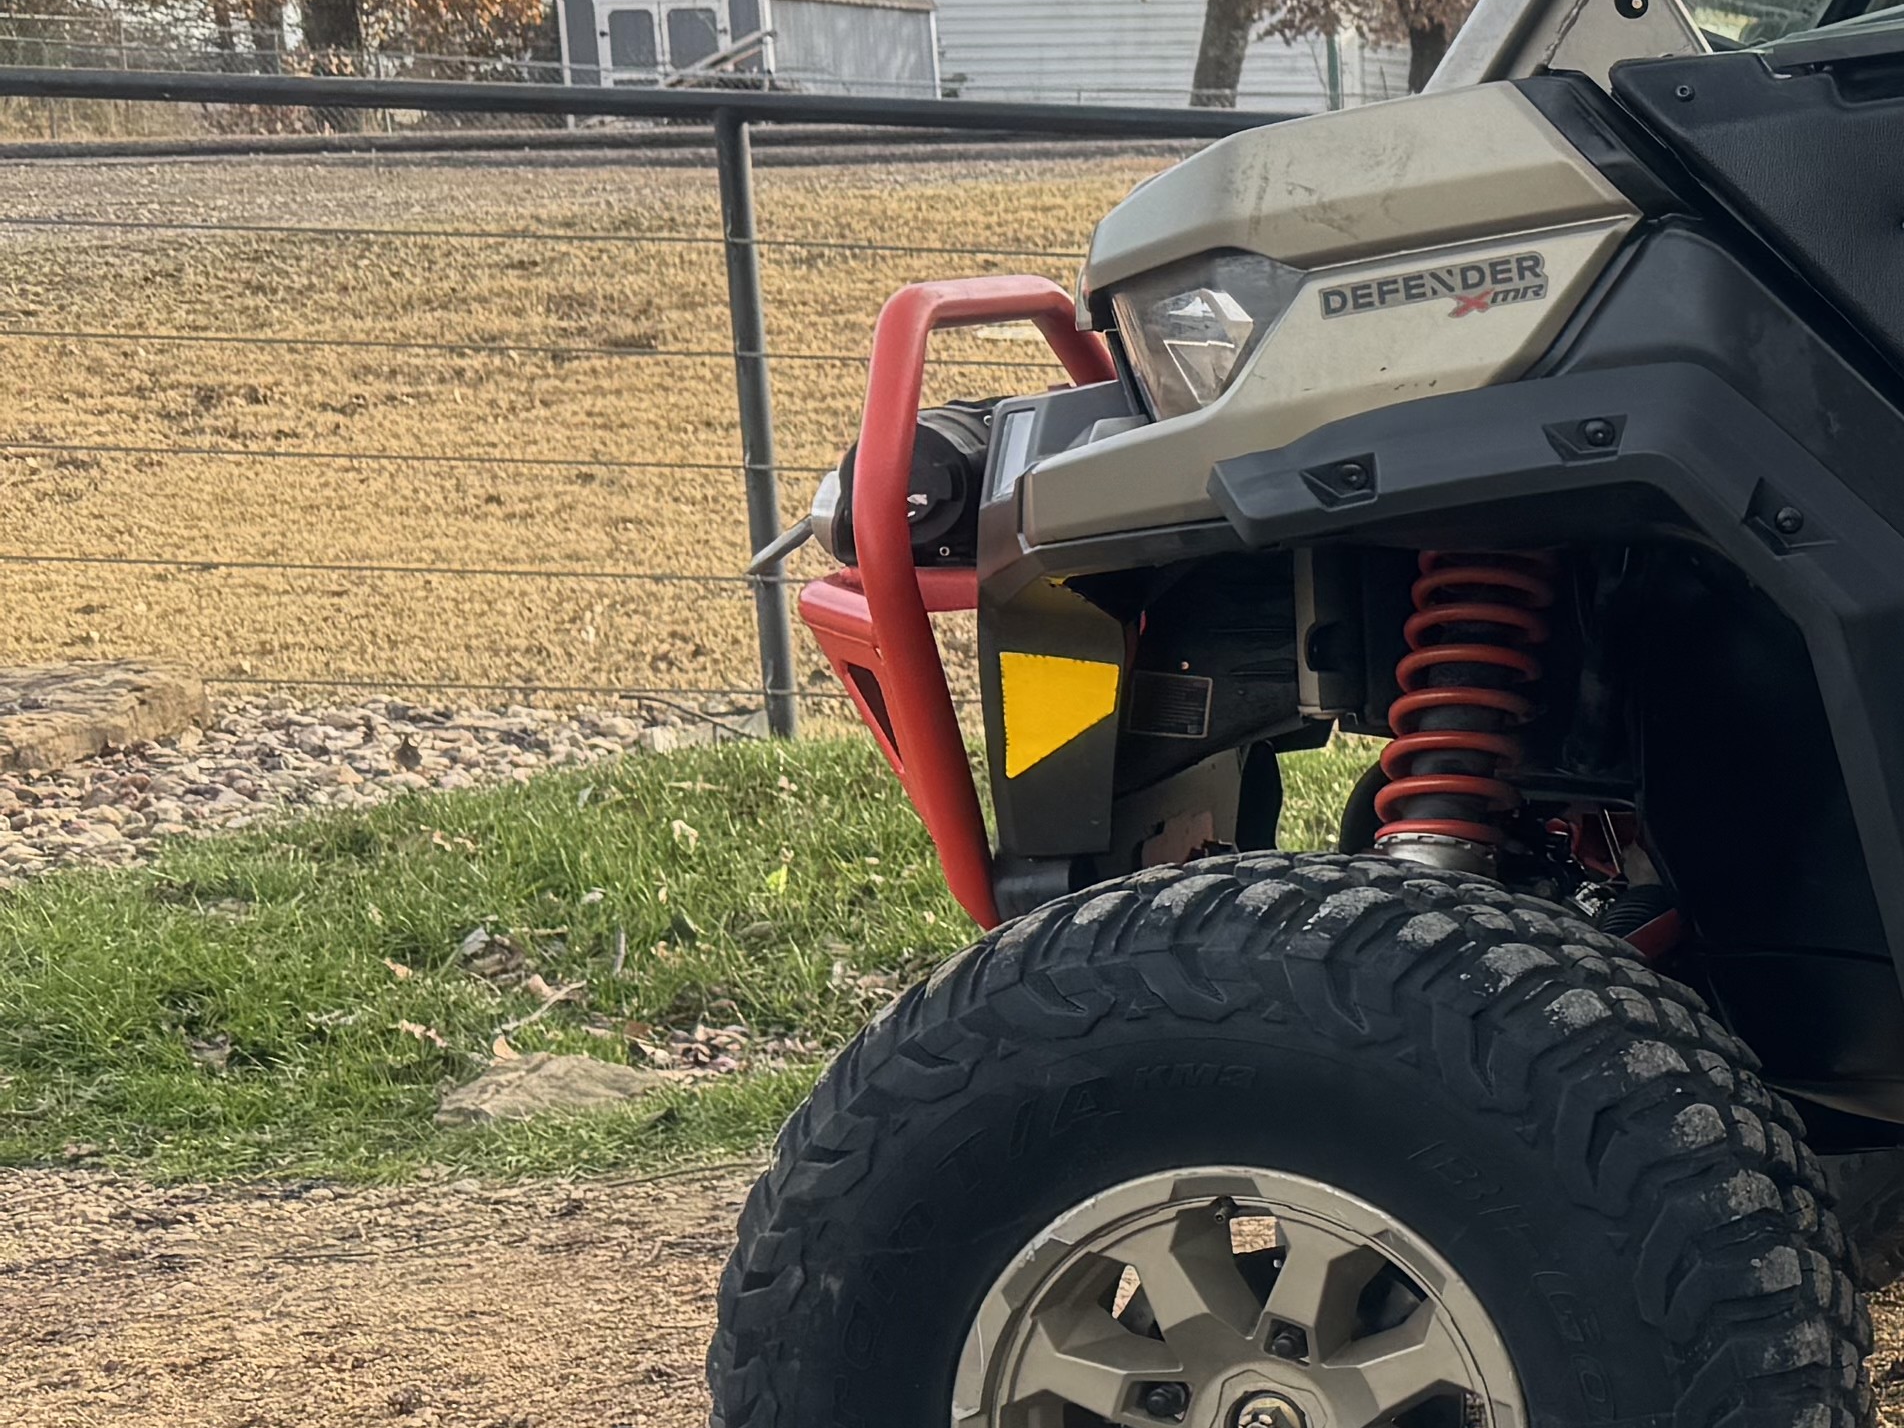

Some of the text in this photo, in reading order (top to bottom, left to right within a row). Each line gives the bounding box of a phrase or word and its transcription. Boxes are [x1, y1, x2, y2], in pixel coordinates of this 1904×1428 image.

[1322, 254, 1542, 315] DEFENDER
[936, 1074, 1122, 1194] T/A
[1131, 1062, 1259, 1093] KM3
